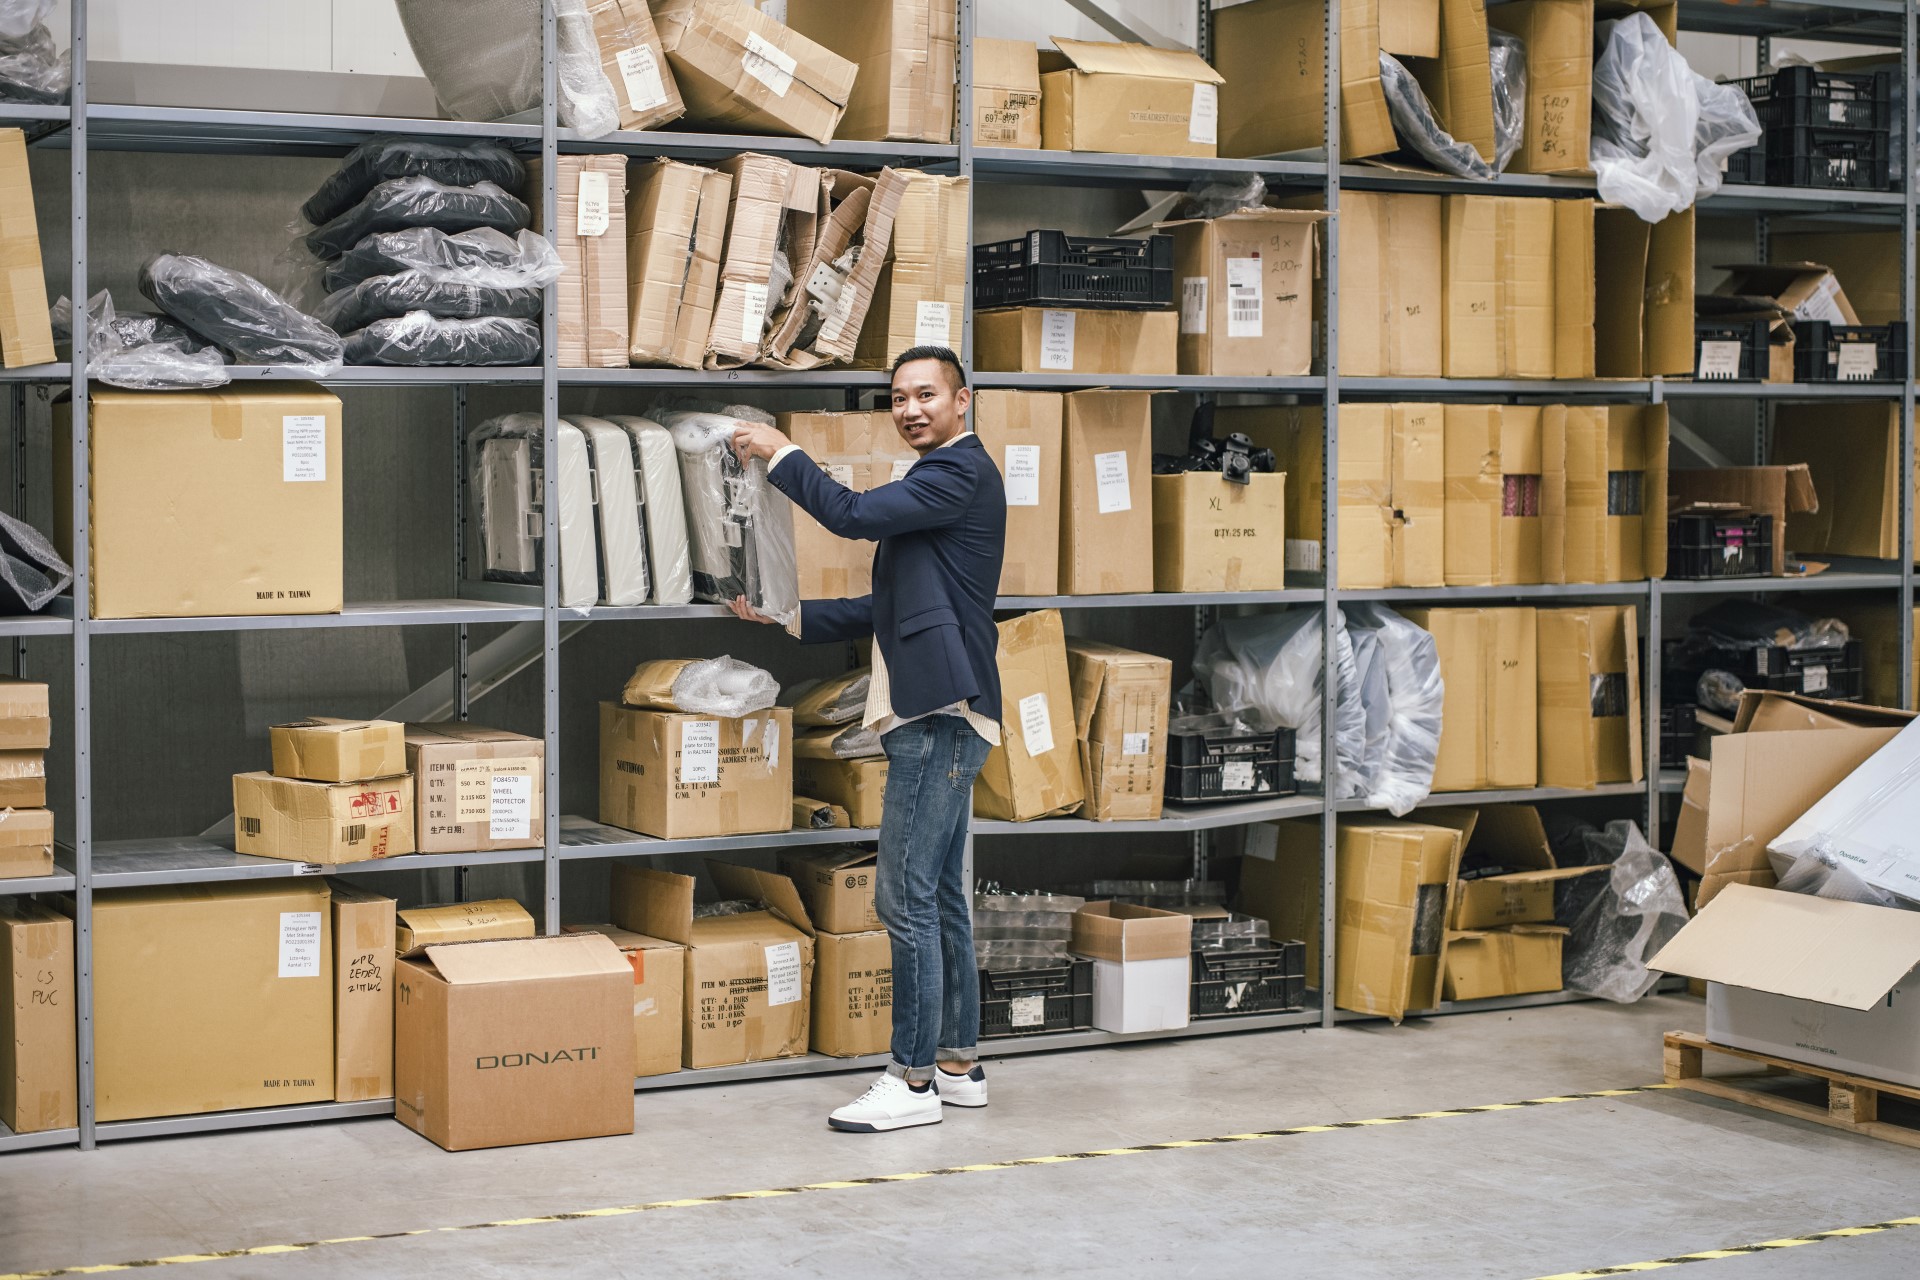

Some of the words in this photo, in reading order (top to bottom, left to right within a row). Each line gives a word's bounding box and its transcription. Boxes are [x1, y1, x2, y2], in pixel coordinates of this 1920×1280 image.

[1209, 496, 1223, 511] XL
[256, 591, 274, 600] MADE
[277, 591, 284, 600] IN
[289, 590, 311, 599] TAIWAN
[430, 764, 445, 772] ITEM
[446, 763, 457, 771] NO.
[848, 971, 862, 979] ITEM
[701, 981, 715, 989] ITEM
[719, 980, 728, 988] NO.
[733, 996, 749, 1004] PAIRS
[476, 1047, 597, 1070] DONATI
[264, 1079, 281, 1088] MADE
[283, 1079, 290, 1087] IN
[292, 1079, 315, 1087] TAIWAN
